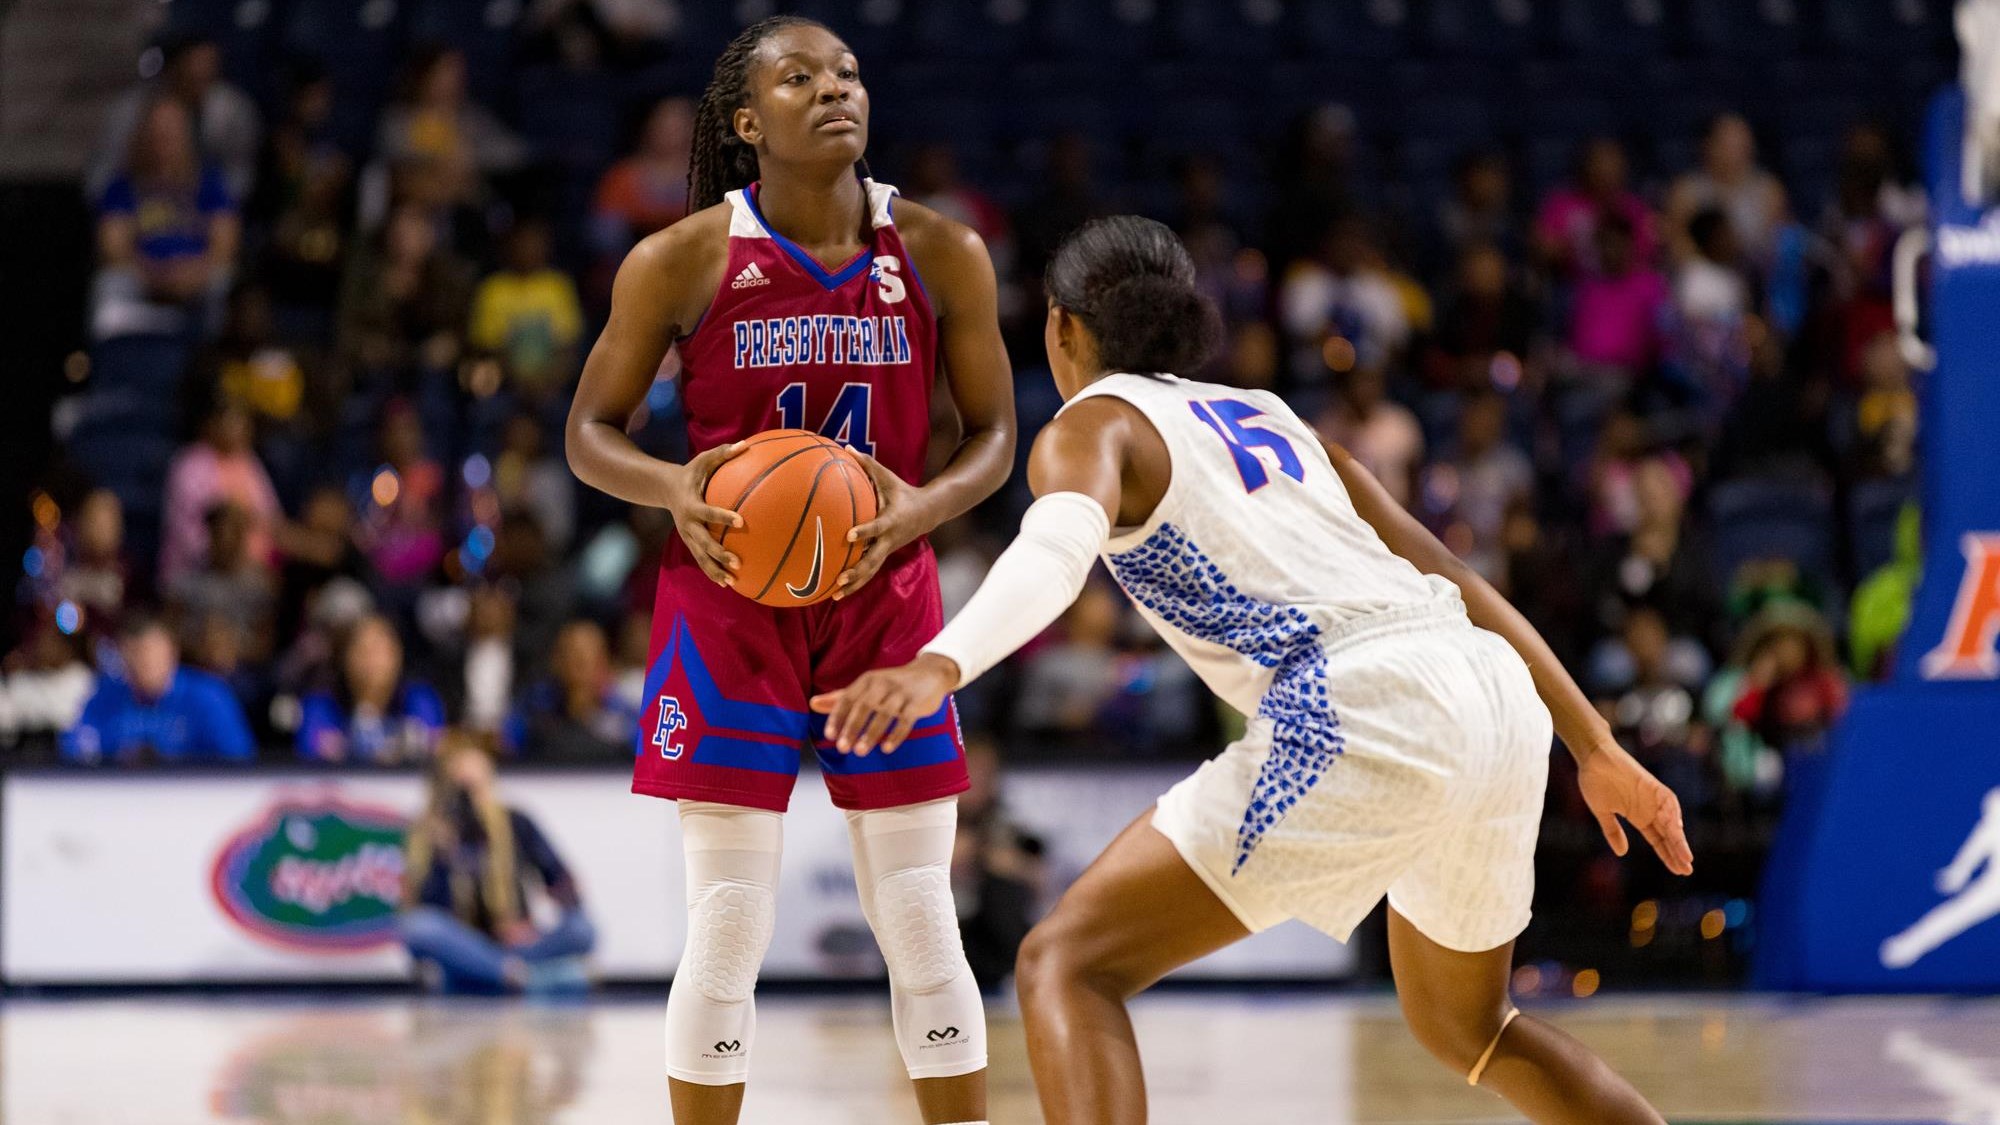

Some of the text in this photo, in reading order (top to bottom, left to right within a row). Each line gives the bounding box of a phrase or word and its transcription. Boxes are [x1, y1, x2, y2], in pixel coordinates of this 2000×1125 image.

[731, 278, 770, 289] adidas
[734, 314, 911, 368] PRESBYTERIAN
[777, 382, 876, 460] 14
[1187, 398, 1305, 494] 15
